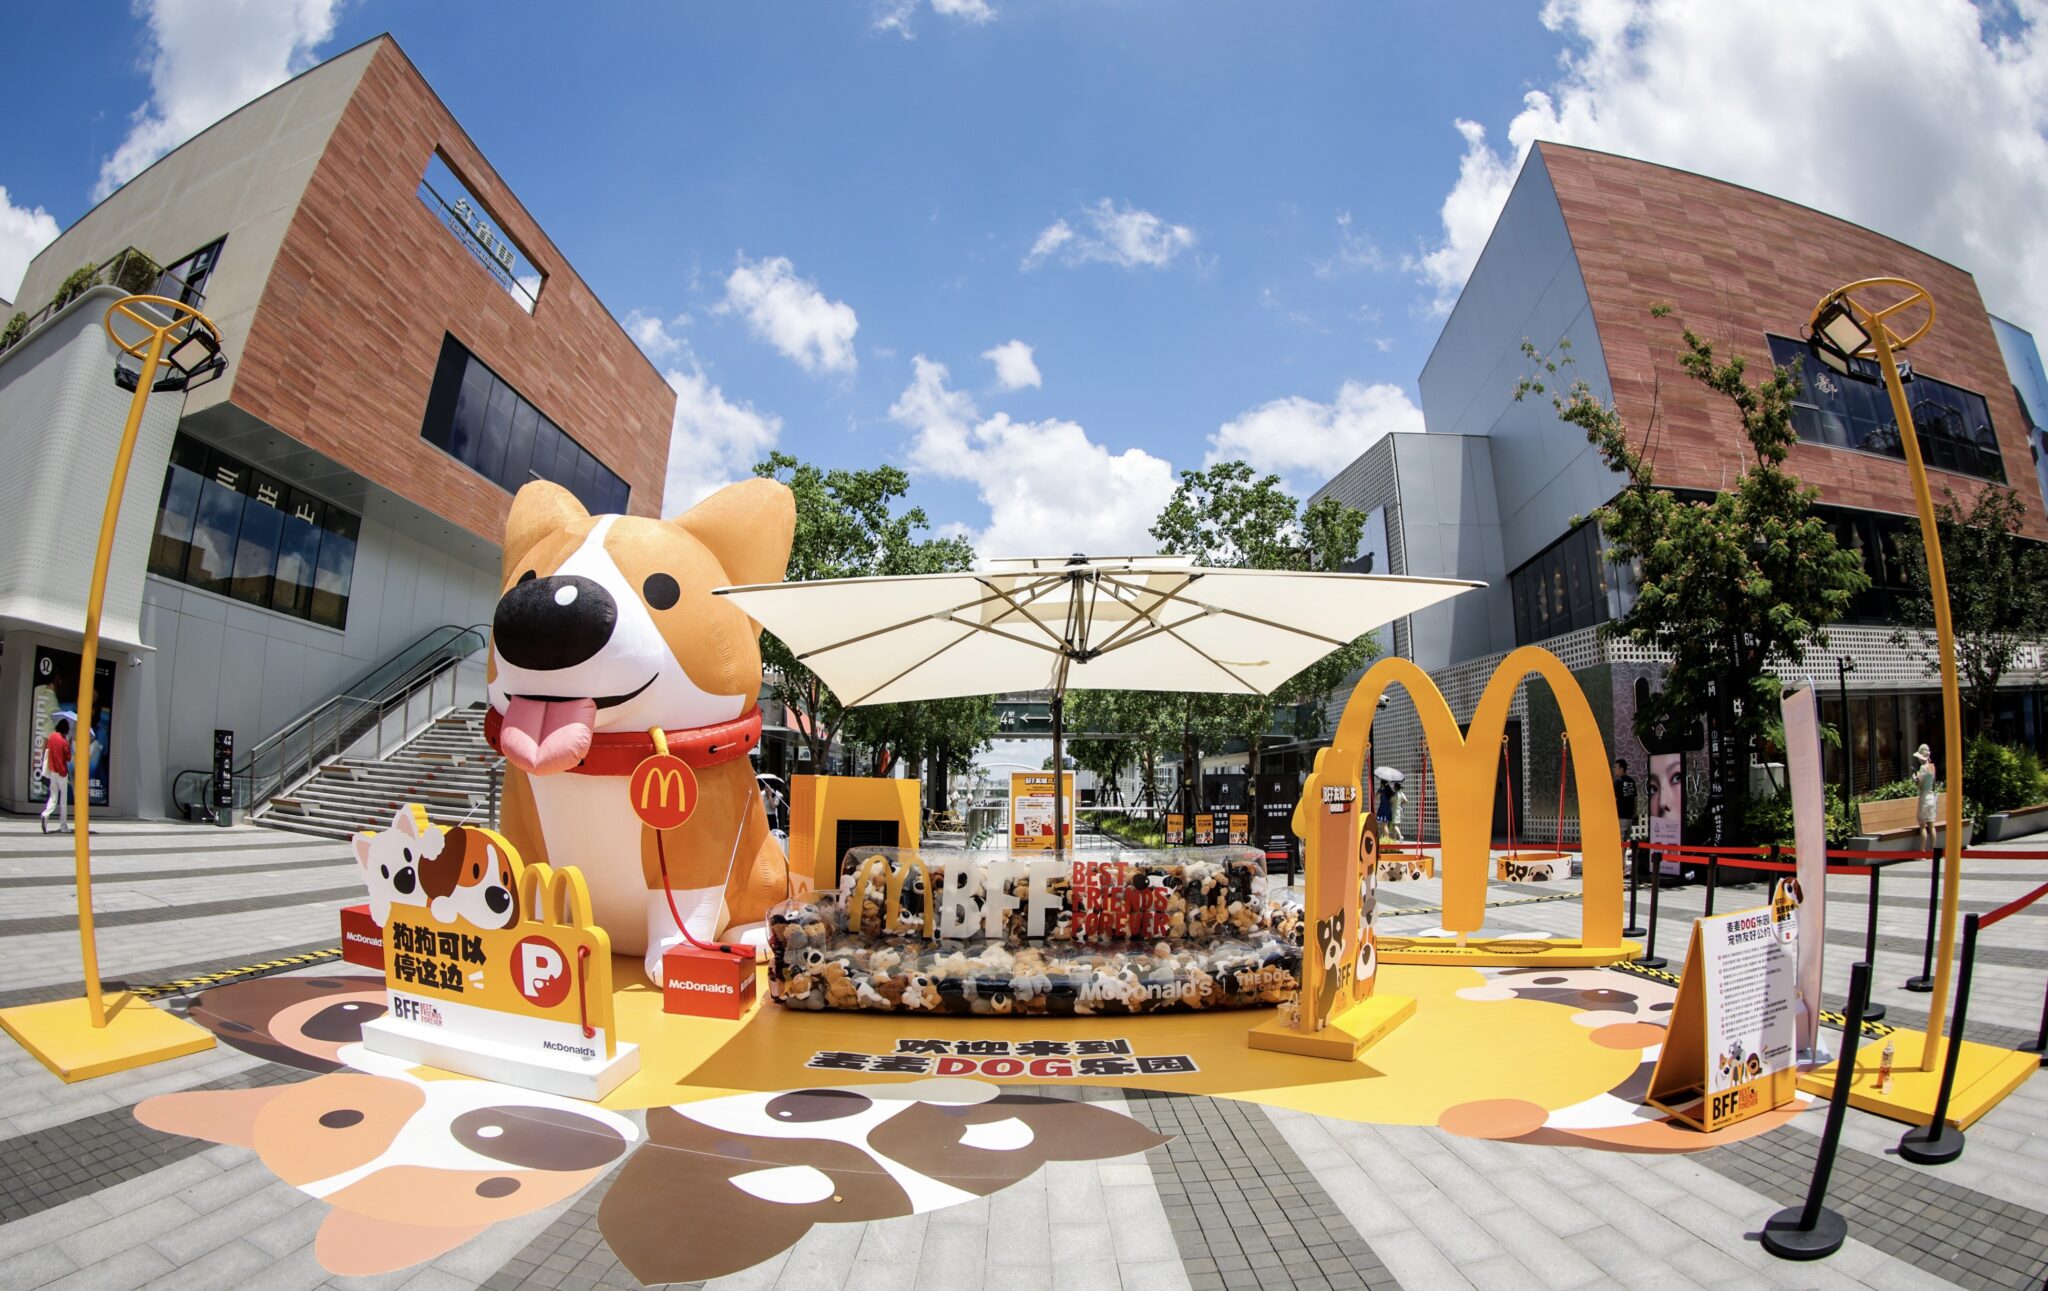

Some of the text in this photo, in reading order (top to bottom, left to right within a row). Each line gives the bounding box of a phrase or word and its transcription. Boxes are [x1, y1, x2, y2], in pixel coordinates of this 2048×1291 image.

[33, 695, 49, 795] lululemon
[1072, 861, 1130, 887] BEST
[942, 858, 1068, 939] BFF
[1072, 887, 1169, 912] FRIENDS
[1072, 912, 1169, 938] FOREVER
[1727, 914, 1770, 933] 麦麦DOG乐园
[1728, 926, 1771, 945] 宠物友好公约
[392, 921, 487, 966] 狗狗可以
[394, 952, 465, 994] 停这边
[1237, 969, 1290, 987] THE DOG
[668, 979, 734, 995] McDonald's
[1079, 978, 1213, 1001] McDonald's
[394, 996, 420, 1021] BFF
[543, 1040, 596, 1057] McDonald's
[897, 1039, 1132, 1056] 欢迎来到
[806, 1051, 1198, 1077] 麦麦DOG乐园
[1713, 1090, 1739, 1121] BFF
